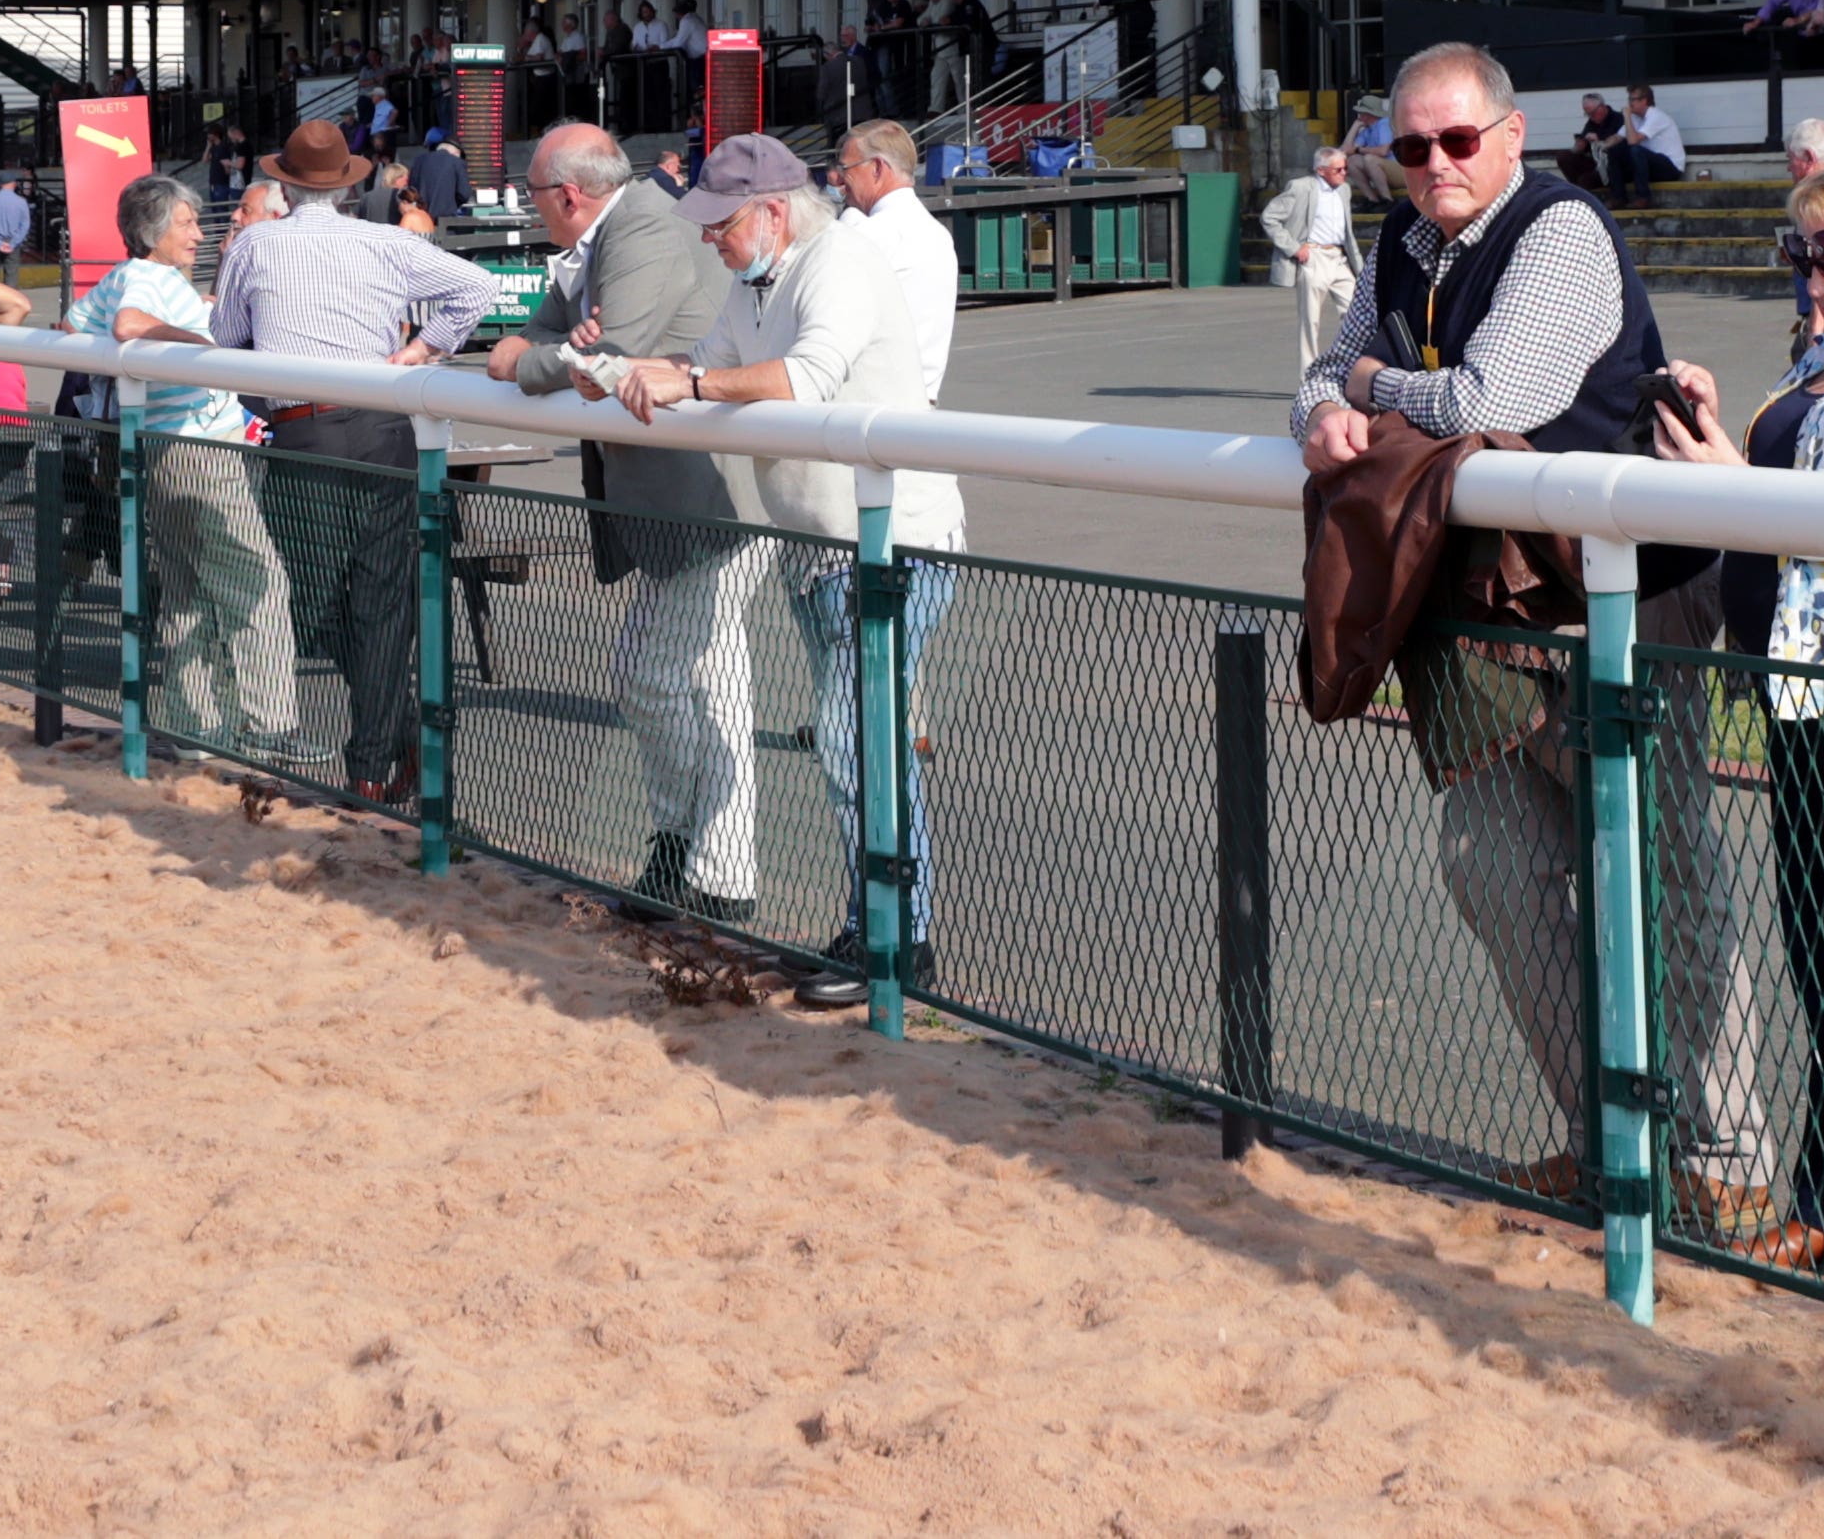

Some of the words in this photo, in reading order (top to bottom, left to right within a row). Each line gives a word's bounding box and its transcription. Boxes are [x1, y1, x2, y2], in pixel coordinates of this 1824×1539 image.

[453, 47, 475, 60] CLIFF
[476, 48, 505, 60] EMERY
[79, 101, 129, 115] TOILETS
[499, 305, 530, 316] TAKEN
